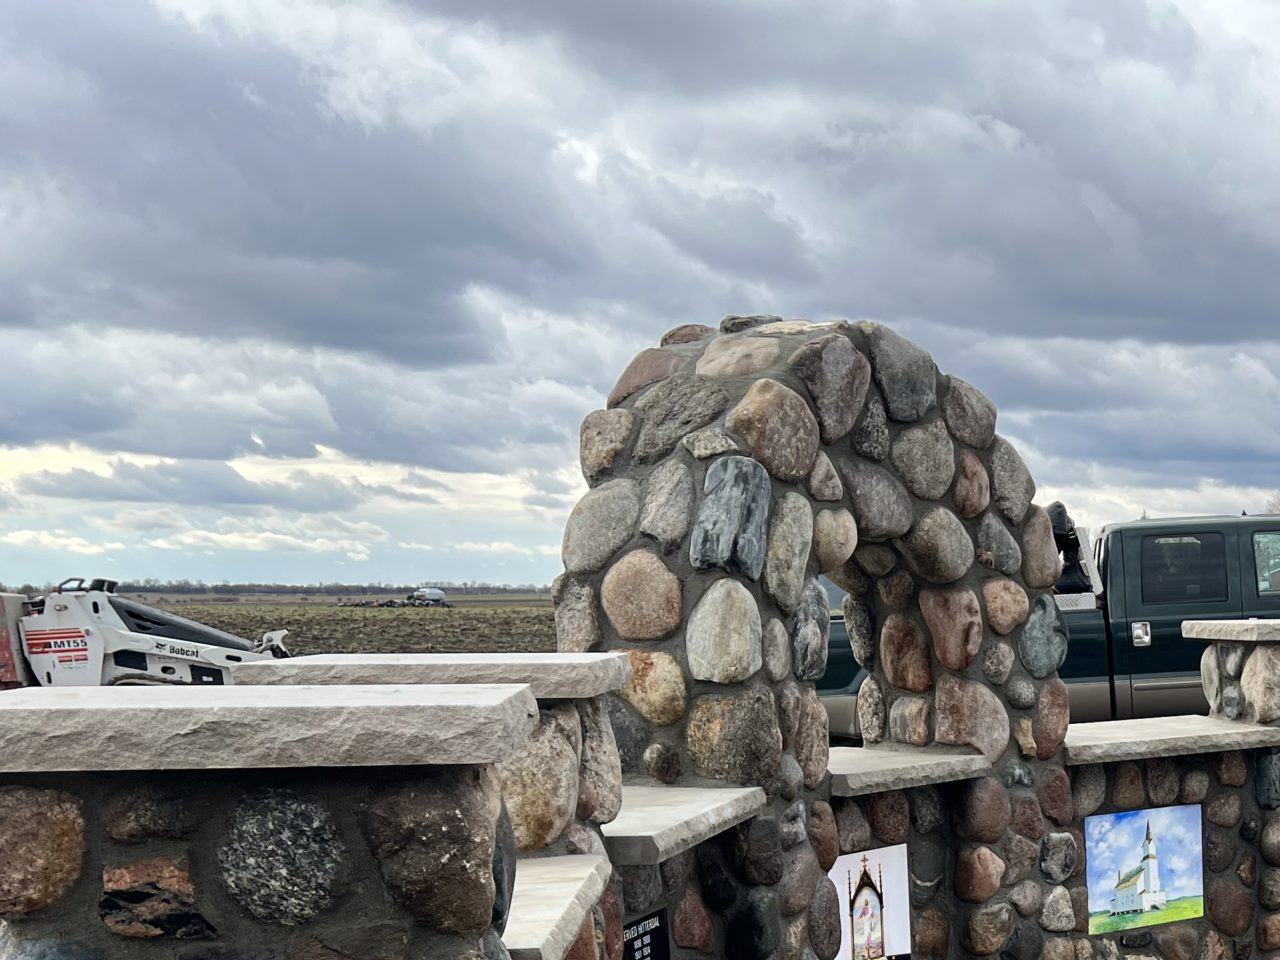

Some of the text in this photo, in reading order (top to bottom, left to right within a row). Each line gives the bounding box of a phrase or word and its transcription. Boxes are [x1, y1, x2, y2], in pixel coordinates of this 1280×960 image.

[54, 639, 87, 649] MT55
[169, 645, 199, 658] Bobcat
[623, 926, 637, 942] ERVED
